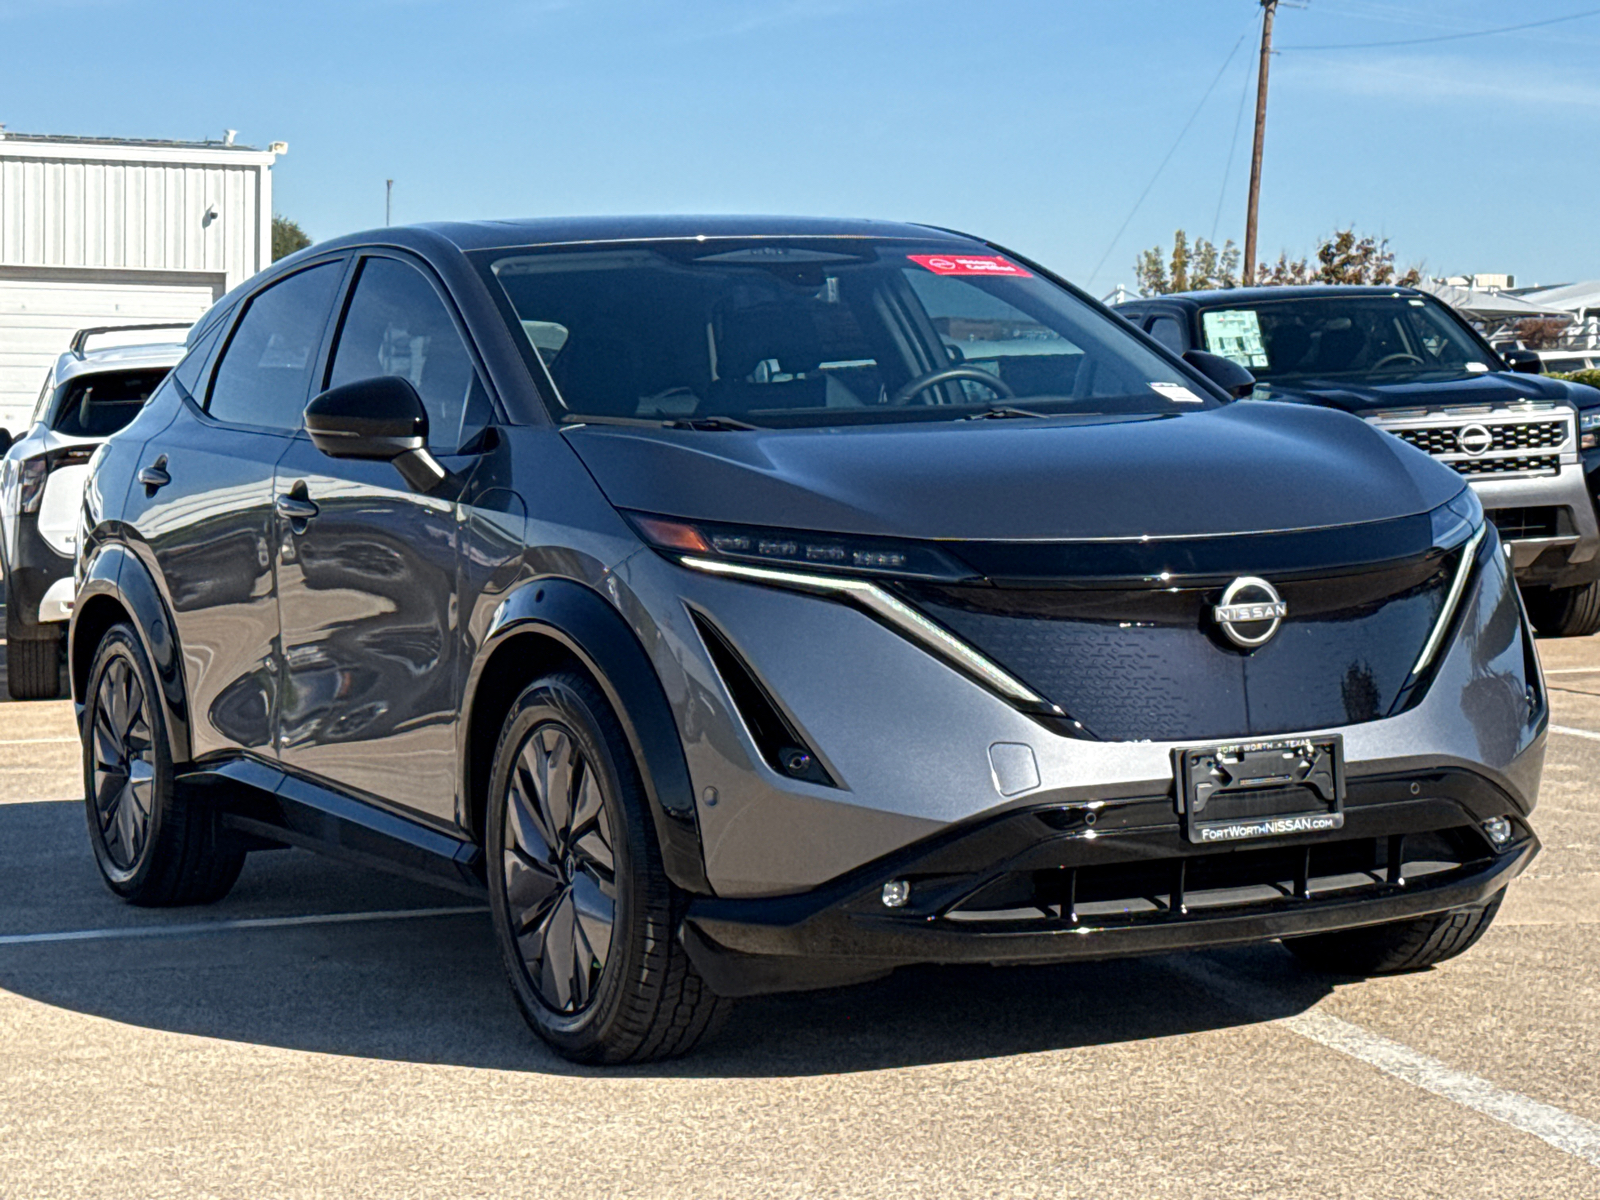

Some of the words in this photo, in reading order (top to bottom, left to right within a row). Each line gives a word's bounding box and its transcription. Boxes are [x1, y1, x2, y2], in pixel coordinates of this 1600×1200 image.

[1217, 605, 1286, 621] NISSAN
[1217, 744, 1240, 754] FORT
[1243, 742, 1273, 751] WORTH
[1284, 738, 1311, 748] TEXAS
